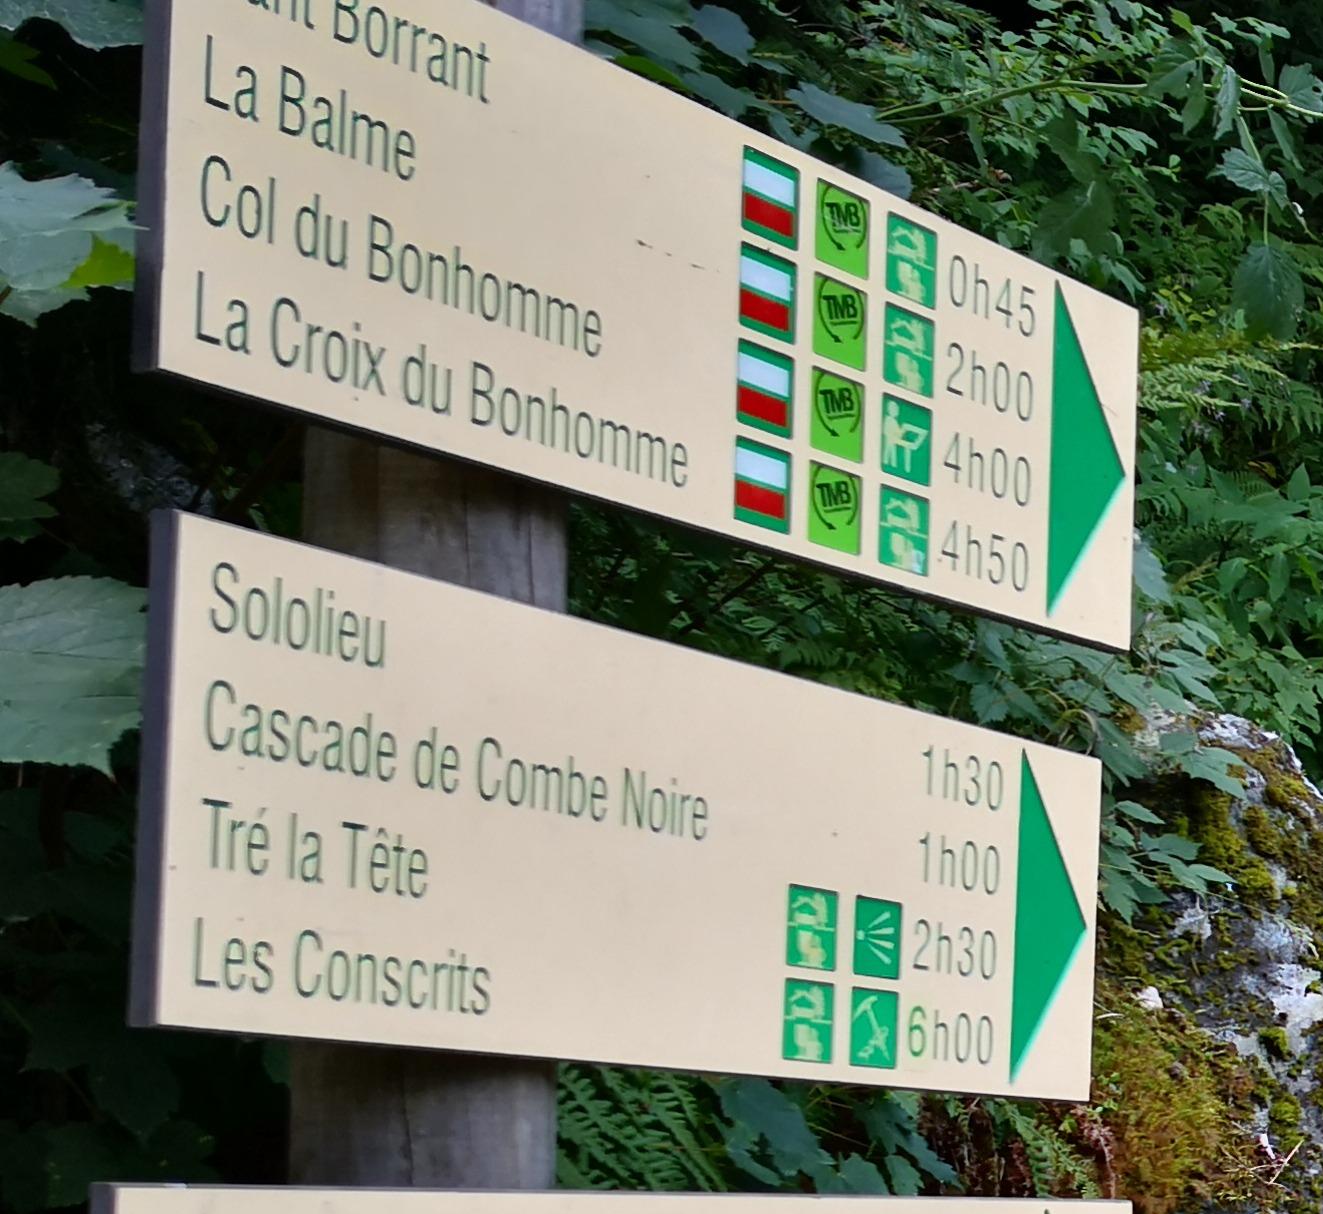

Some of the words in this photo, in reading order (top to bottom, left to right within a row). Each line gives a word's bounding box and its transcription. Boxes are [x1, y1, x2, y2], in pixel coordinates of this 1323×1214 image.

[333, 0, 490, 104] Borrant
[204, 34, 260, 123] La
[278, 64, 417, 182] Balme
[824, 201, 862, 229] TMB
[200, 154, 277, 246] Col
[295, 193, 349, 270] du
[368, 214, 603, 358] Bonhomme
[823, 292, 859, 319] TMB
[949, 255, 1036, 338] 0h45
[195, 270, 252, 355] La
[271, 296, 388, 397] Croix
[403, 342, 452, 416] du
[471, 359, 689, 489] Bonhomme
[819, 387, 855, 413] TMB
[946, 342, 1034, 422] 2h00
[815, 480, 852, 506] TMB
[943, 431, 1032, 508] 4h00
[941, 519, 1030, 592] 4h50
[209, 560, 387, 669] Sololieu
[204, 679, 398, 784] Cascade
[413, 726, 461, 795] de
[476, 735, 609, 823] Combe
[621, 766, 709, 842] Noire
[922, 744, 1004, 812] 1h30
[201, 797, 271, 876] Tré
[288, 812, 325, 885] la
[341, 819, 430, 900] Tête
[919, 831, 1001, 896] 1h00
[191, 916, 275, 994] Les
[293, 928, 492, 1017] Conscrits
[912, 919, 997, 981] 2h30
[907, 1005, 994, 1066] 6h00
